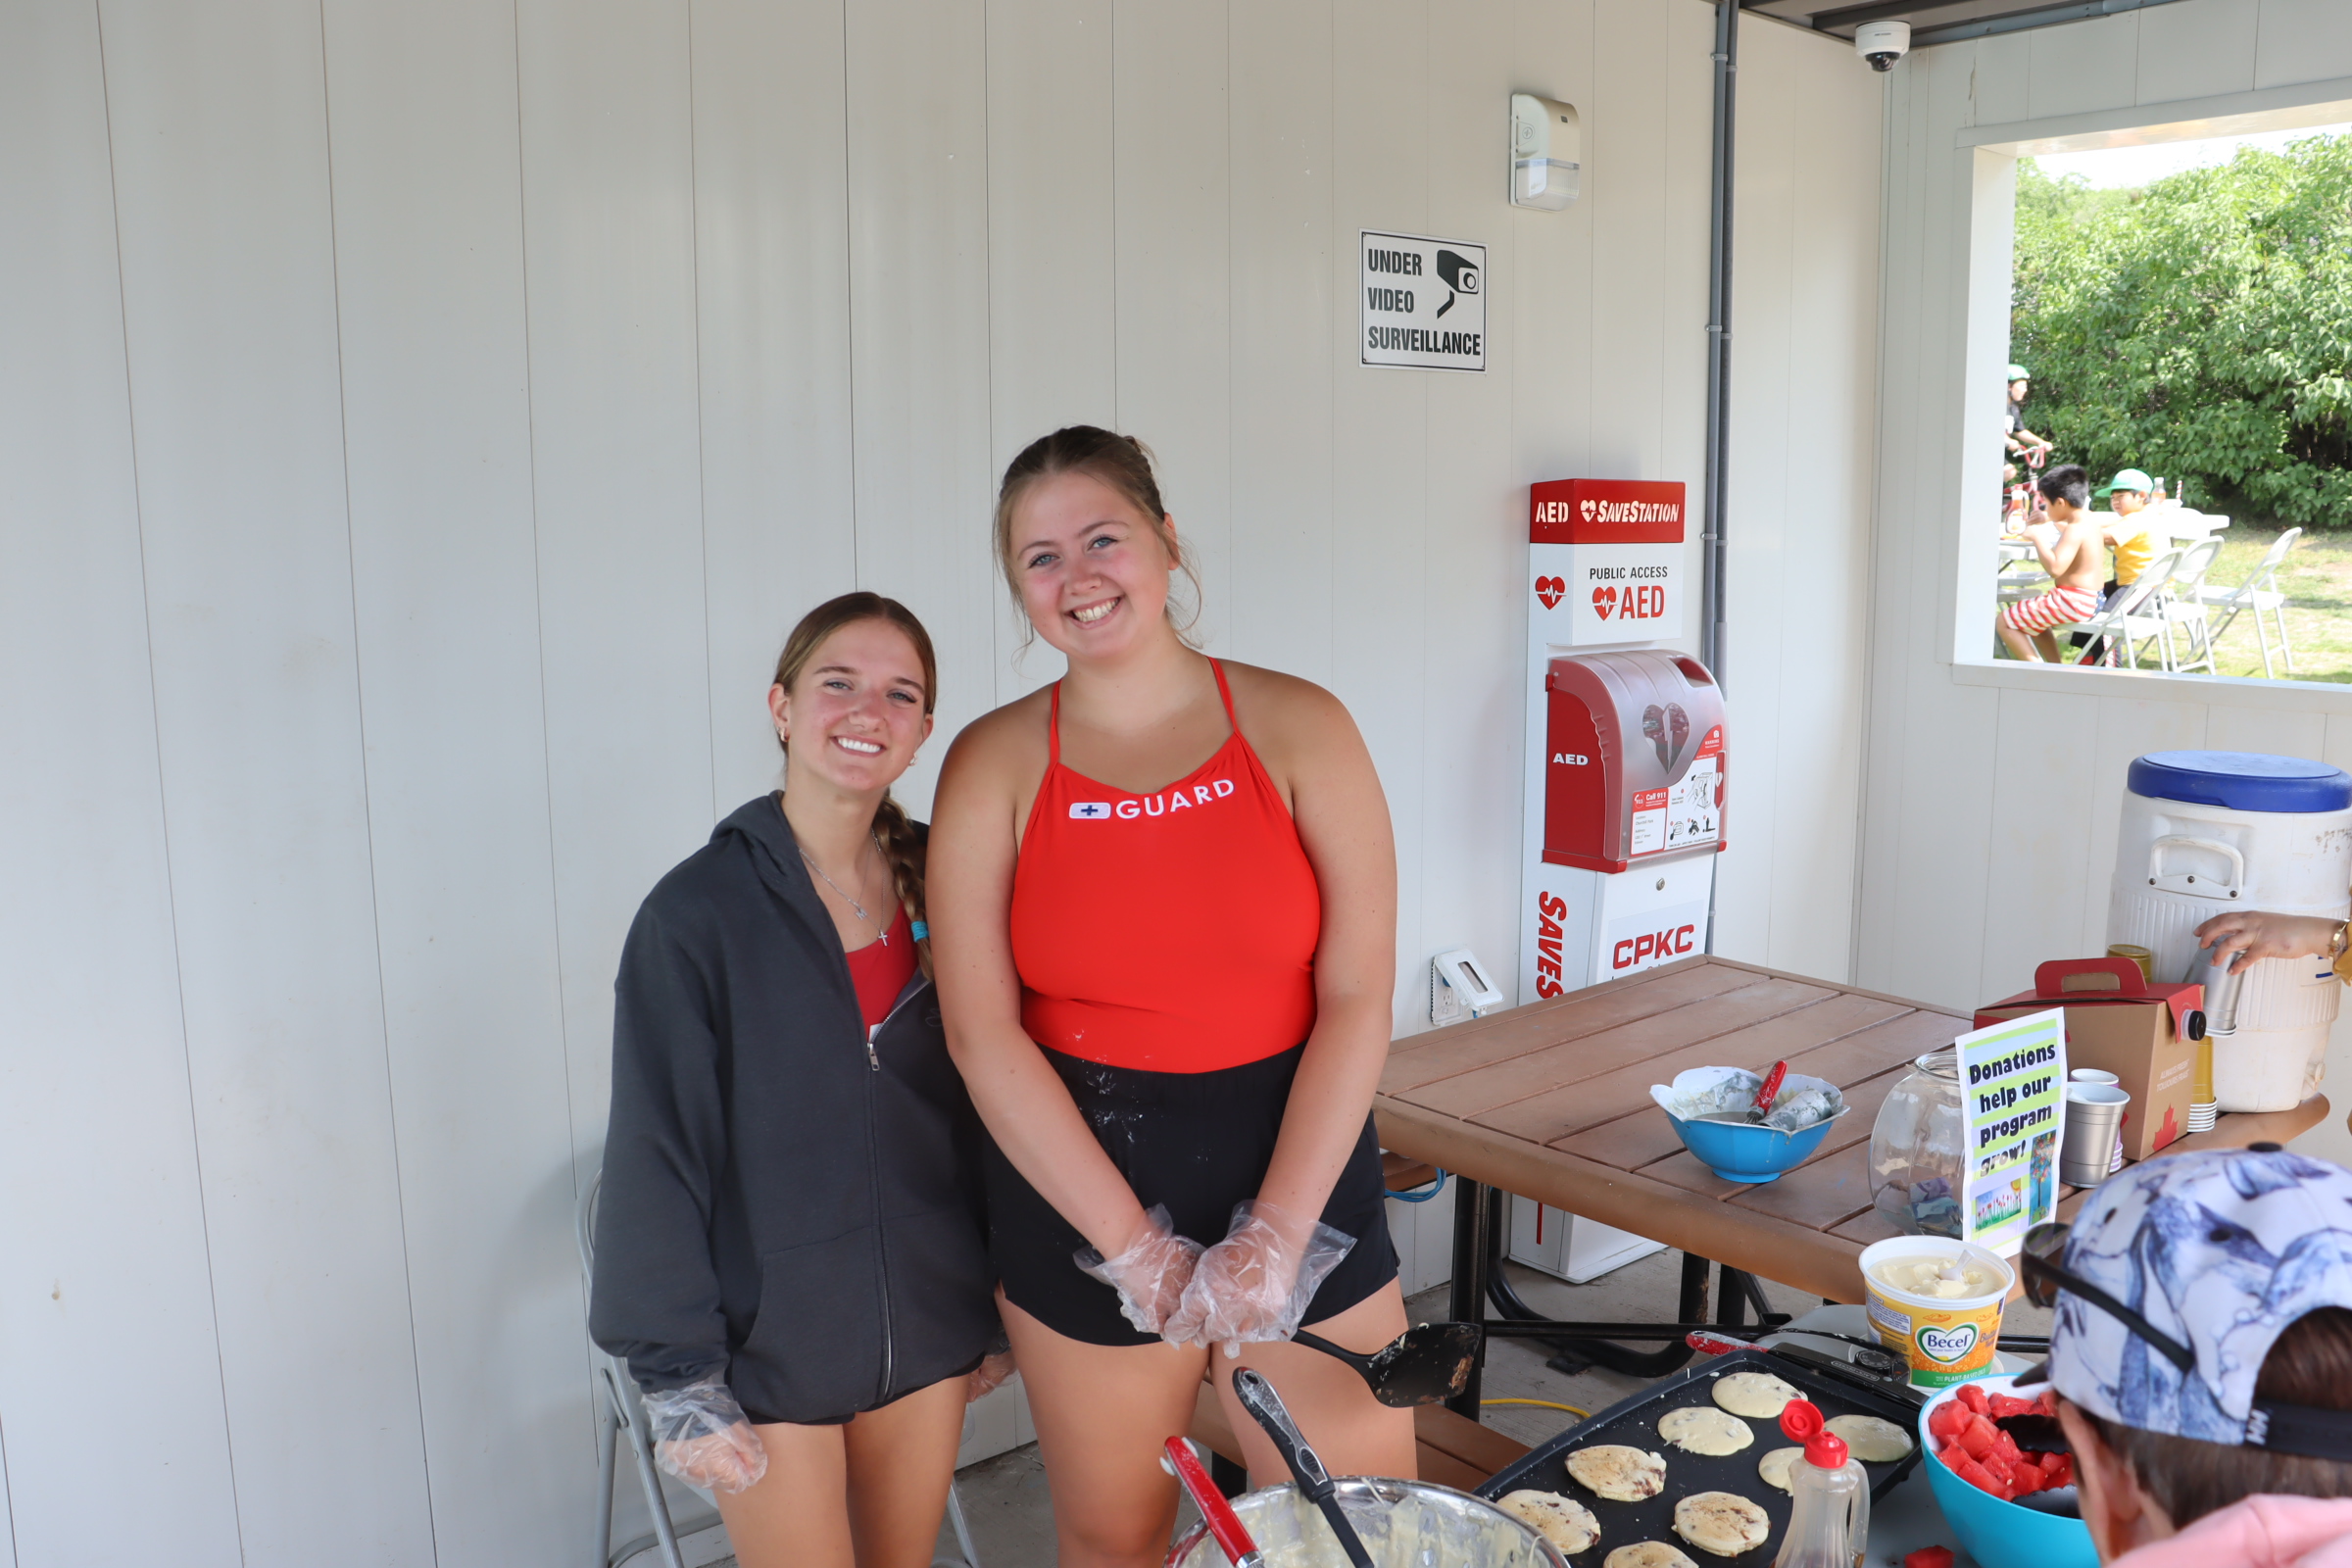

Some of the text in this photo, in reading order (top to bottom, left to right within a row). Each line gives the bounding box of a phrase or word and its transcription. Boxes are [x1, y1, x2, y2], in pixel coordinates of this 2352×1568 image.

[1368, 248, 1422, 276] UNDER
[1367, 287, 1414, 314] VIDEO
[1368, 325, 1481, 356] SURVEILLANCE
[1535, 501, 1569, 523] AED
[1590, 566, 1668, 580] PUBLIC ACCESS
[1619, 585, 1665, 619] AED
[1552, 753, 1589, 765] AED
[1115, 779, 1235, 819] GUARD
[1612, 924, 1694, 970] CPKC
[1969, 1044, 2056, 1085] Donations
[1979, 1075, 2052, 1113] help our
[1980, 1104, 2052, 1149] program
[1980, 1140, 2026, 1178] grow!
[1927, 1334, 1968, 1348] Becel
